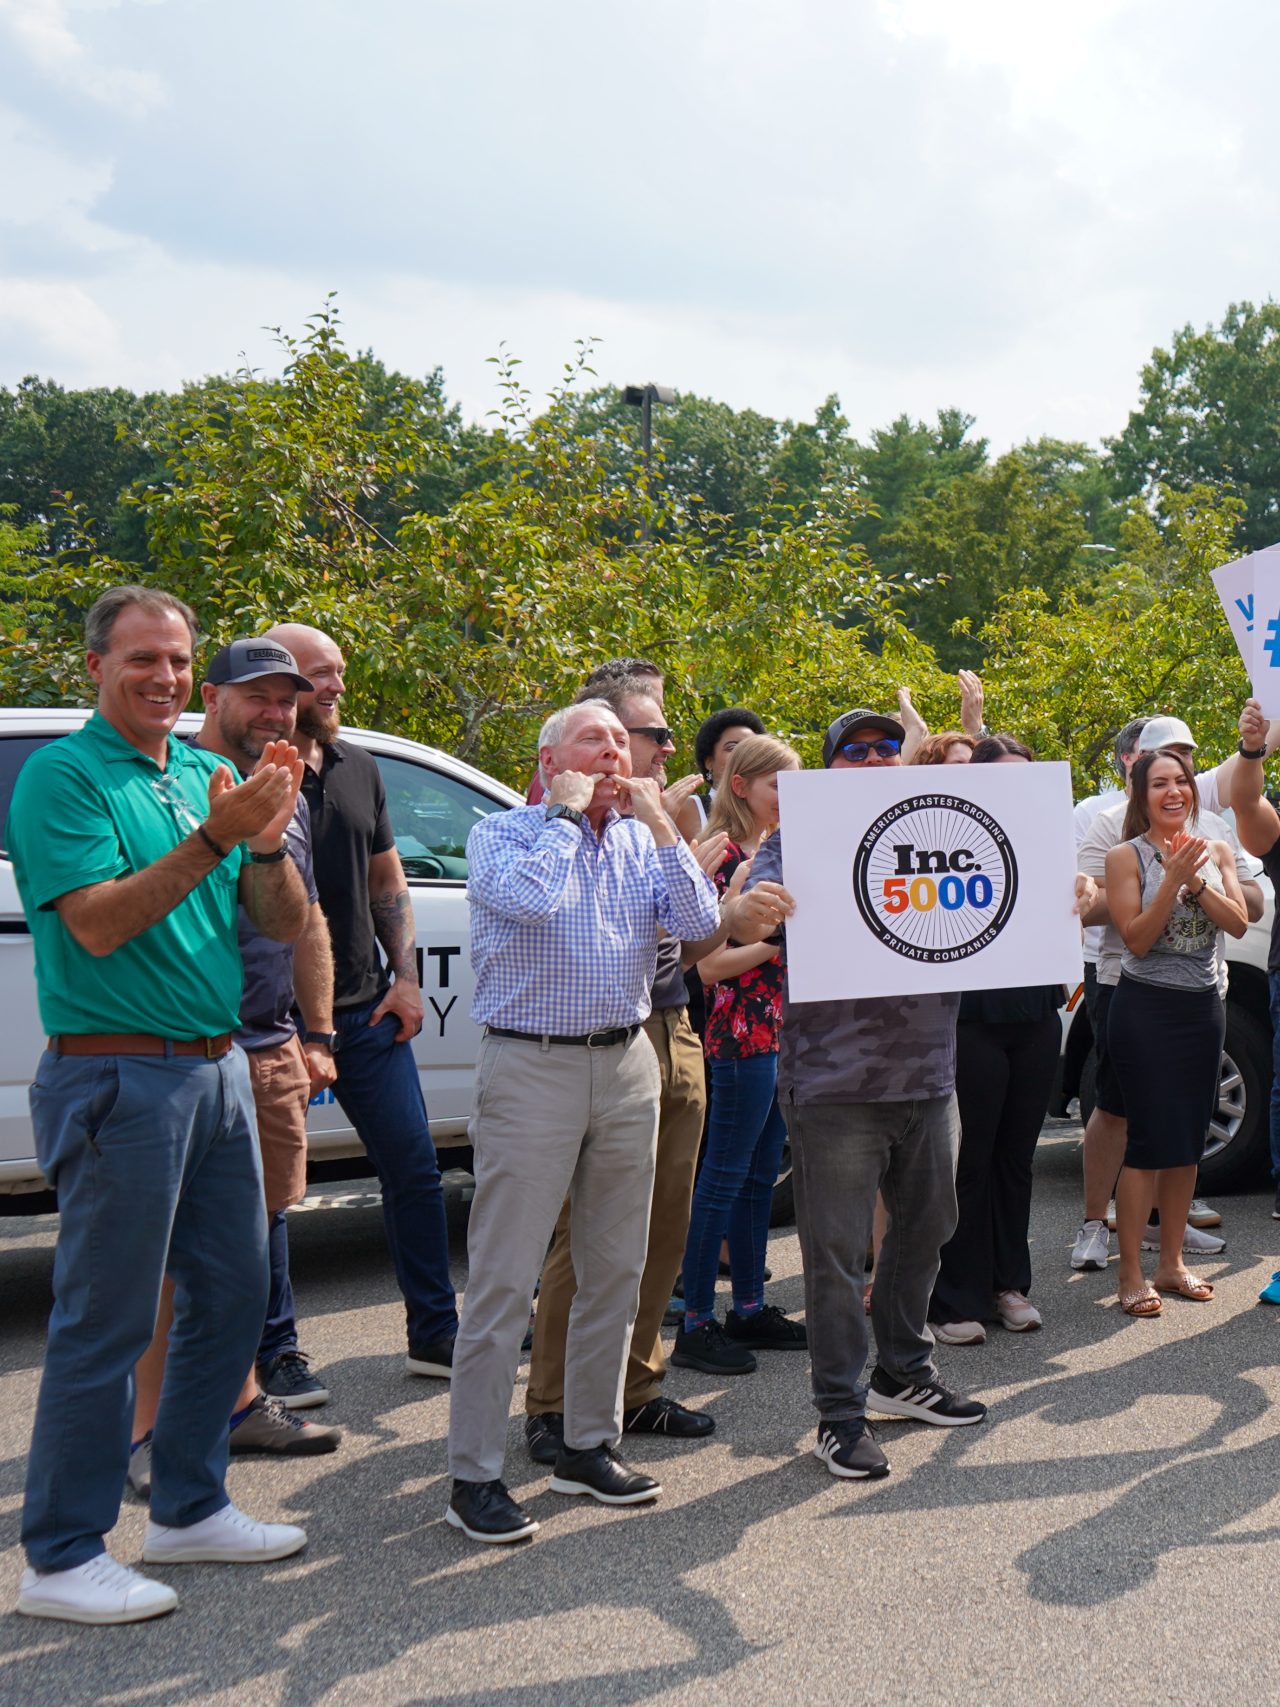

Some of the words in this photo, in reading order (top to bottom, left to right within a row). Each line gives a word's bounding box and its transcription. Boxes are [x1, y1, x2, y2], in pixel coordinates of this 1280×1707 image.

[863, 802, 910, 849] AMERICA'S
[912, 796, 1005, 843] FASTEST-GROWING
[893, 844, 982, 876] Inc.
[882, 873, 993, 914] 5000
[882, 932, 929, 961] PRIVATE
[933, 926, 997, 961] COMPANIES
